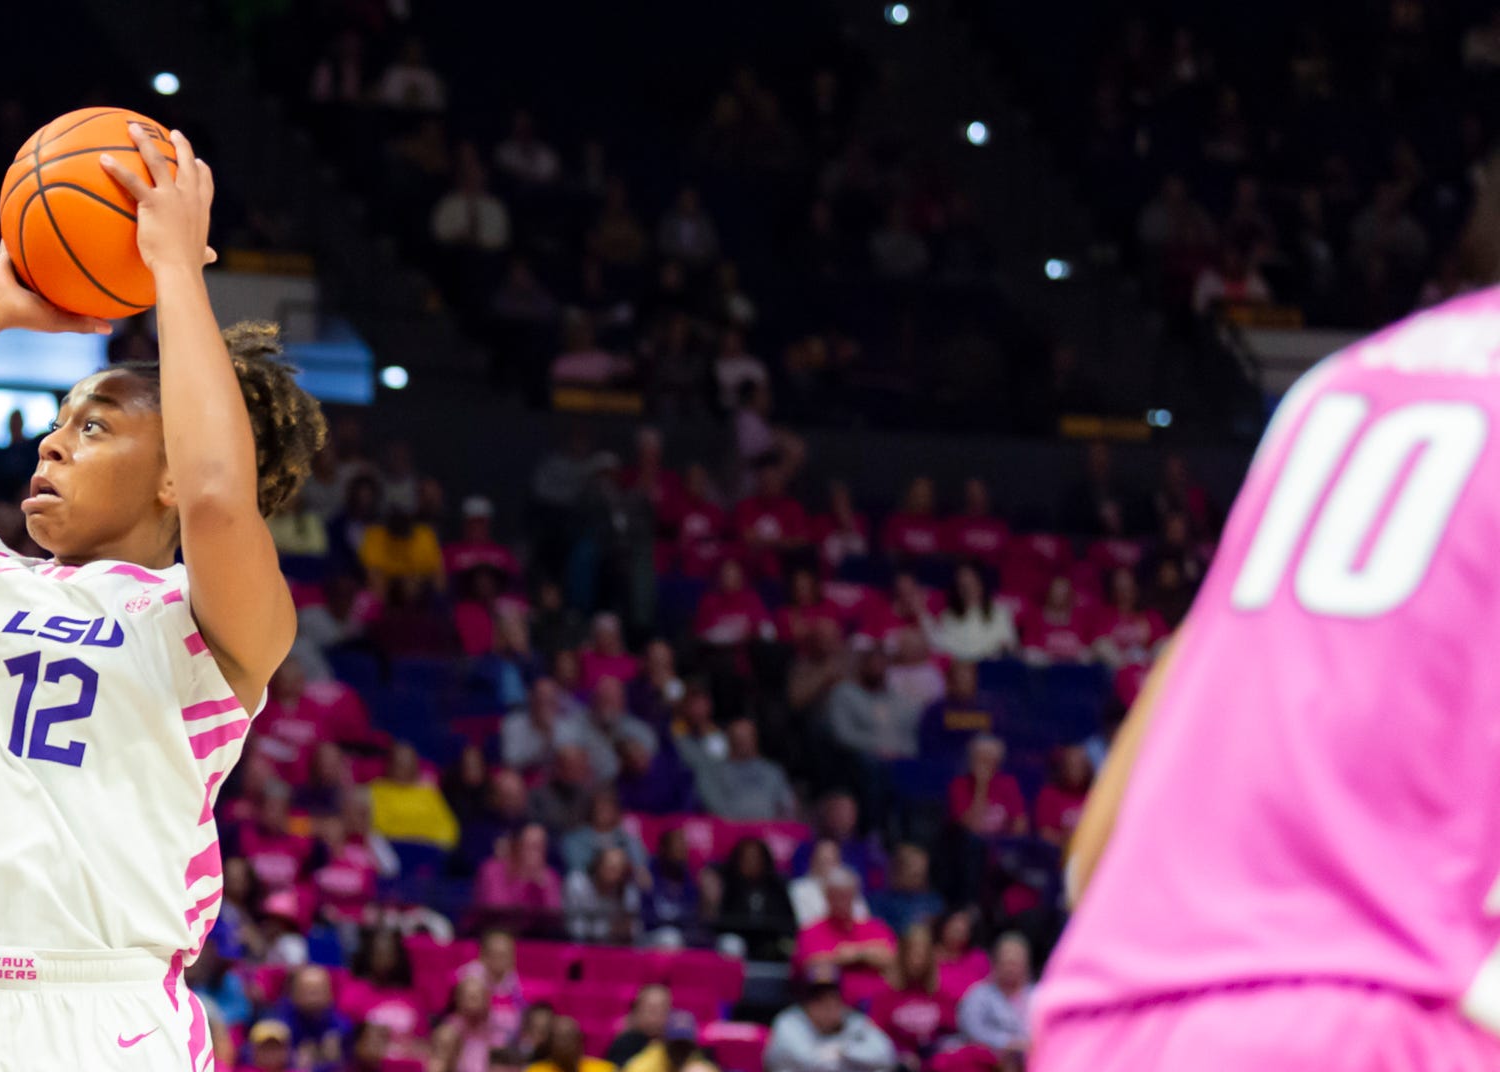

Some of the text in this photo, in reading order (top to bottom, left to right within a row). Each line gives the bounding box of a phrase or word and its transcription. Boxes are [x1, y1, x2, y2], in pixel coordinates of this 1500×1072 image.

[1229, 394, 1488, 619] 10
[1, 610, 125, 648] LSU
[3, 650, 99, 768] 12
